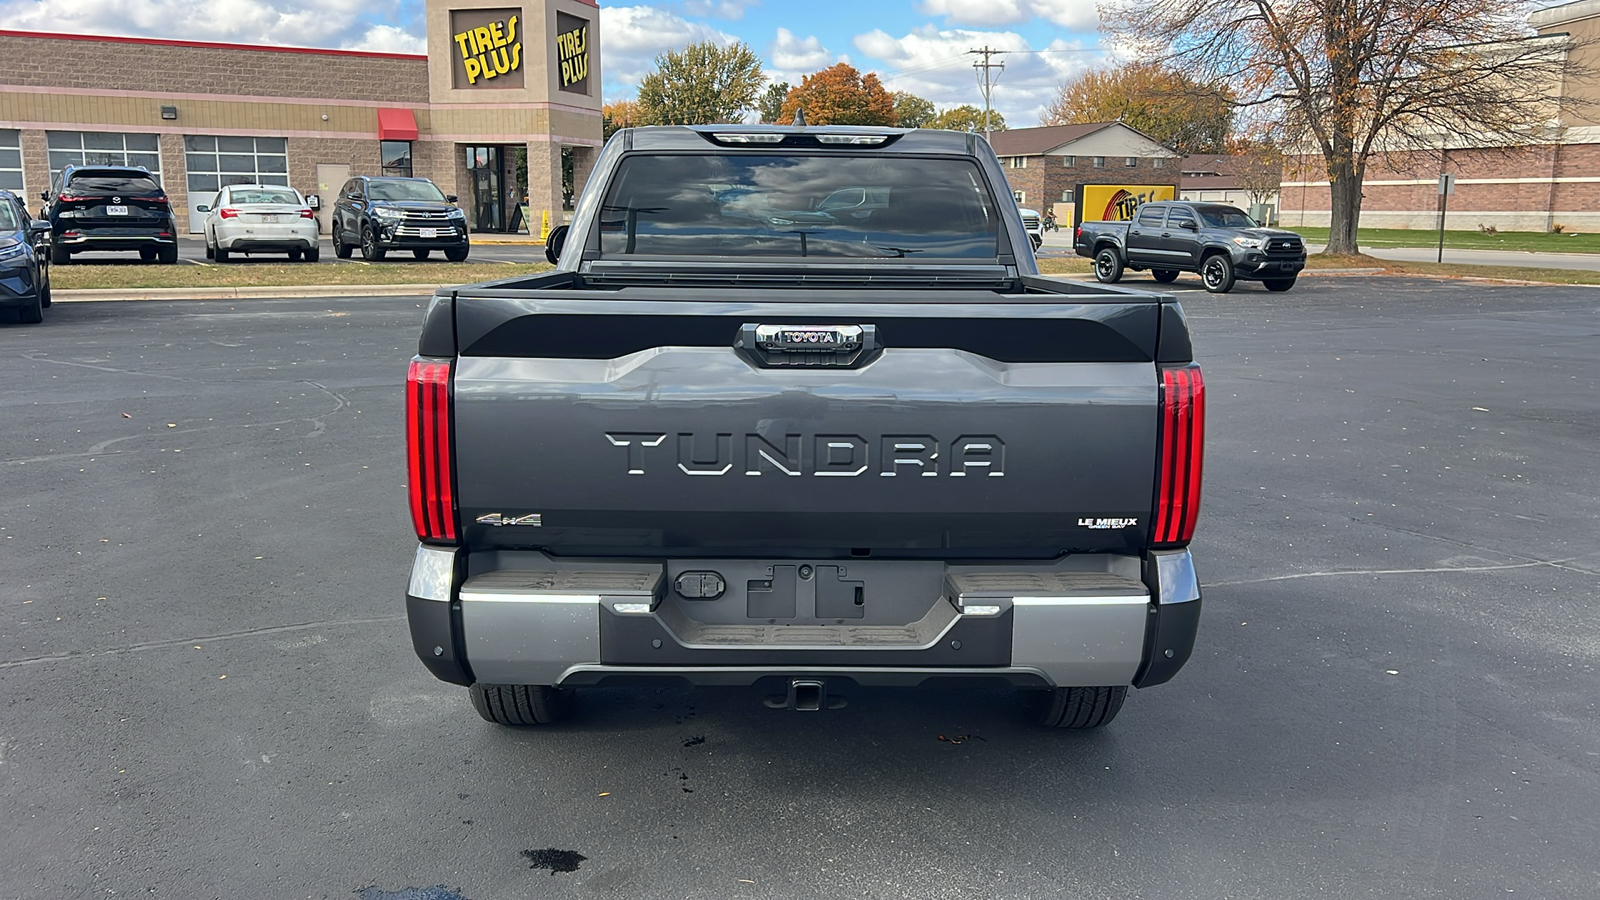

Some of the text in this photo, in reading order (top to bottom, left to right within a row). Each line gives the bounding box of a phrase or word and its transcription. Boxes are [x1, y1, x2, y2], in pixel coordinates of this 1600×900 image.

[454, 15, 518, 59] TIRES
[556, 26, 587, 61] TIRES
[463, 42, 521, 84] PLUS
[561, 52, 588, 87] PLUS
[784, 331, 834, 343] TOYOTA
[604, 431, 1006, 477] TUNDRA
